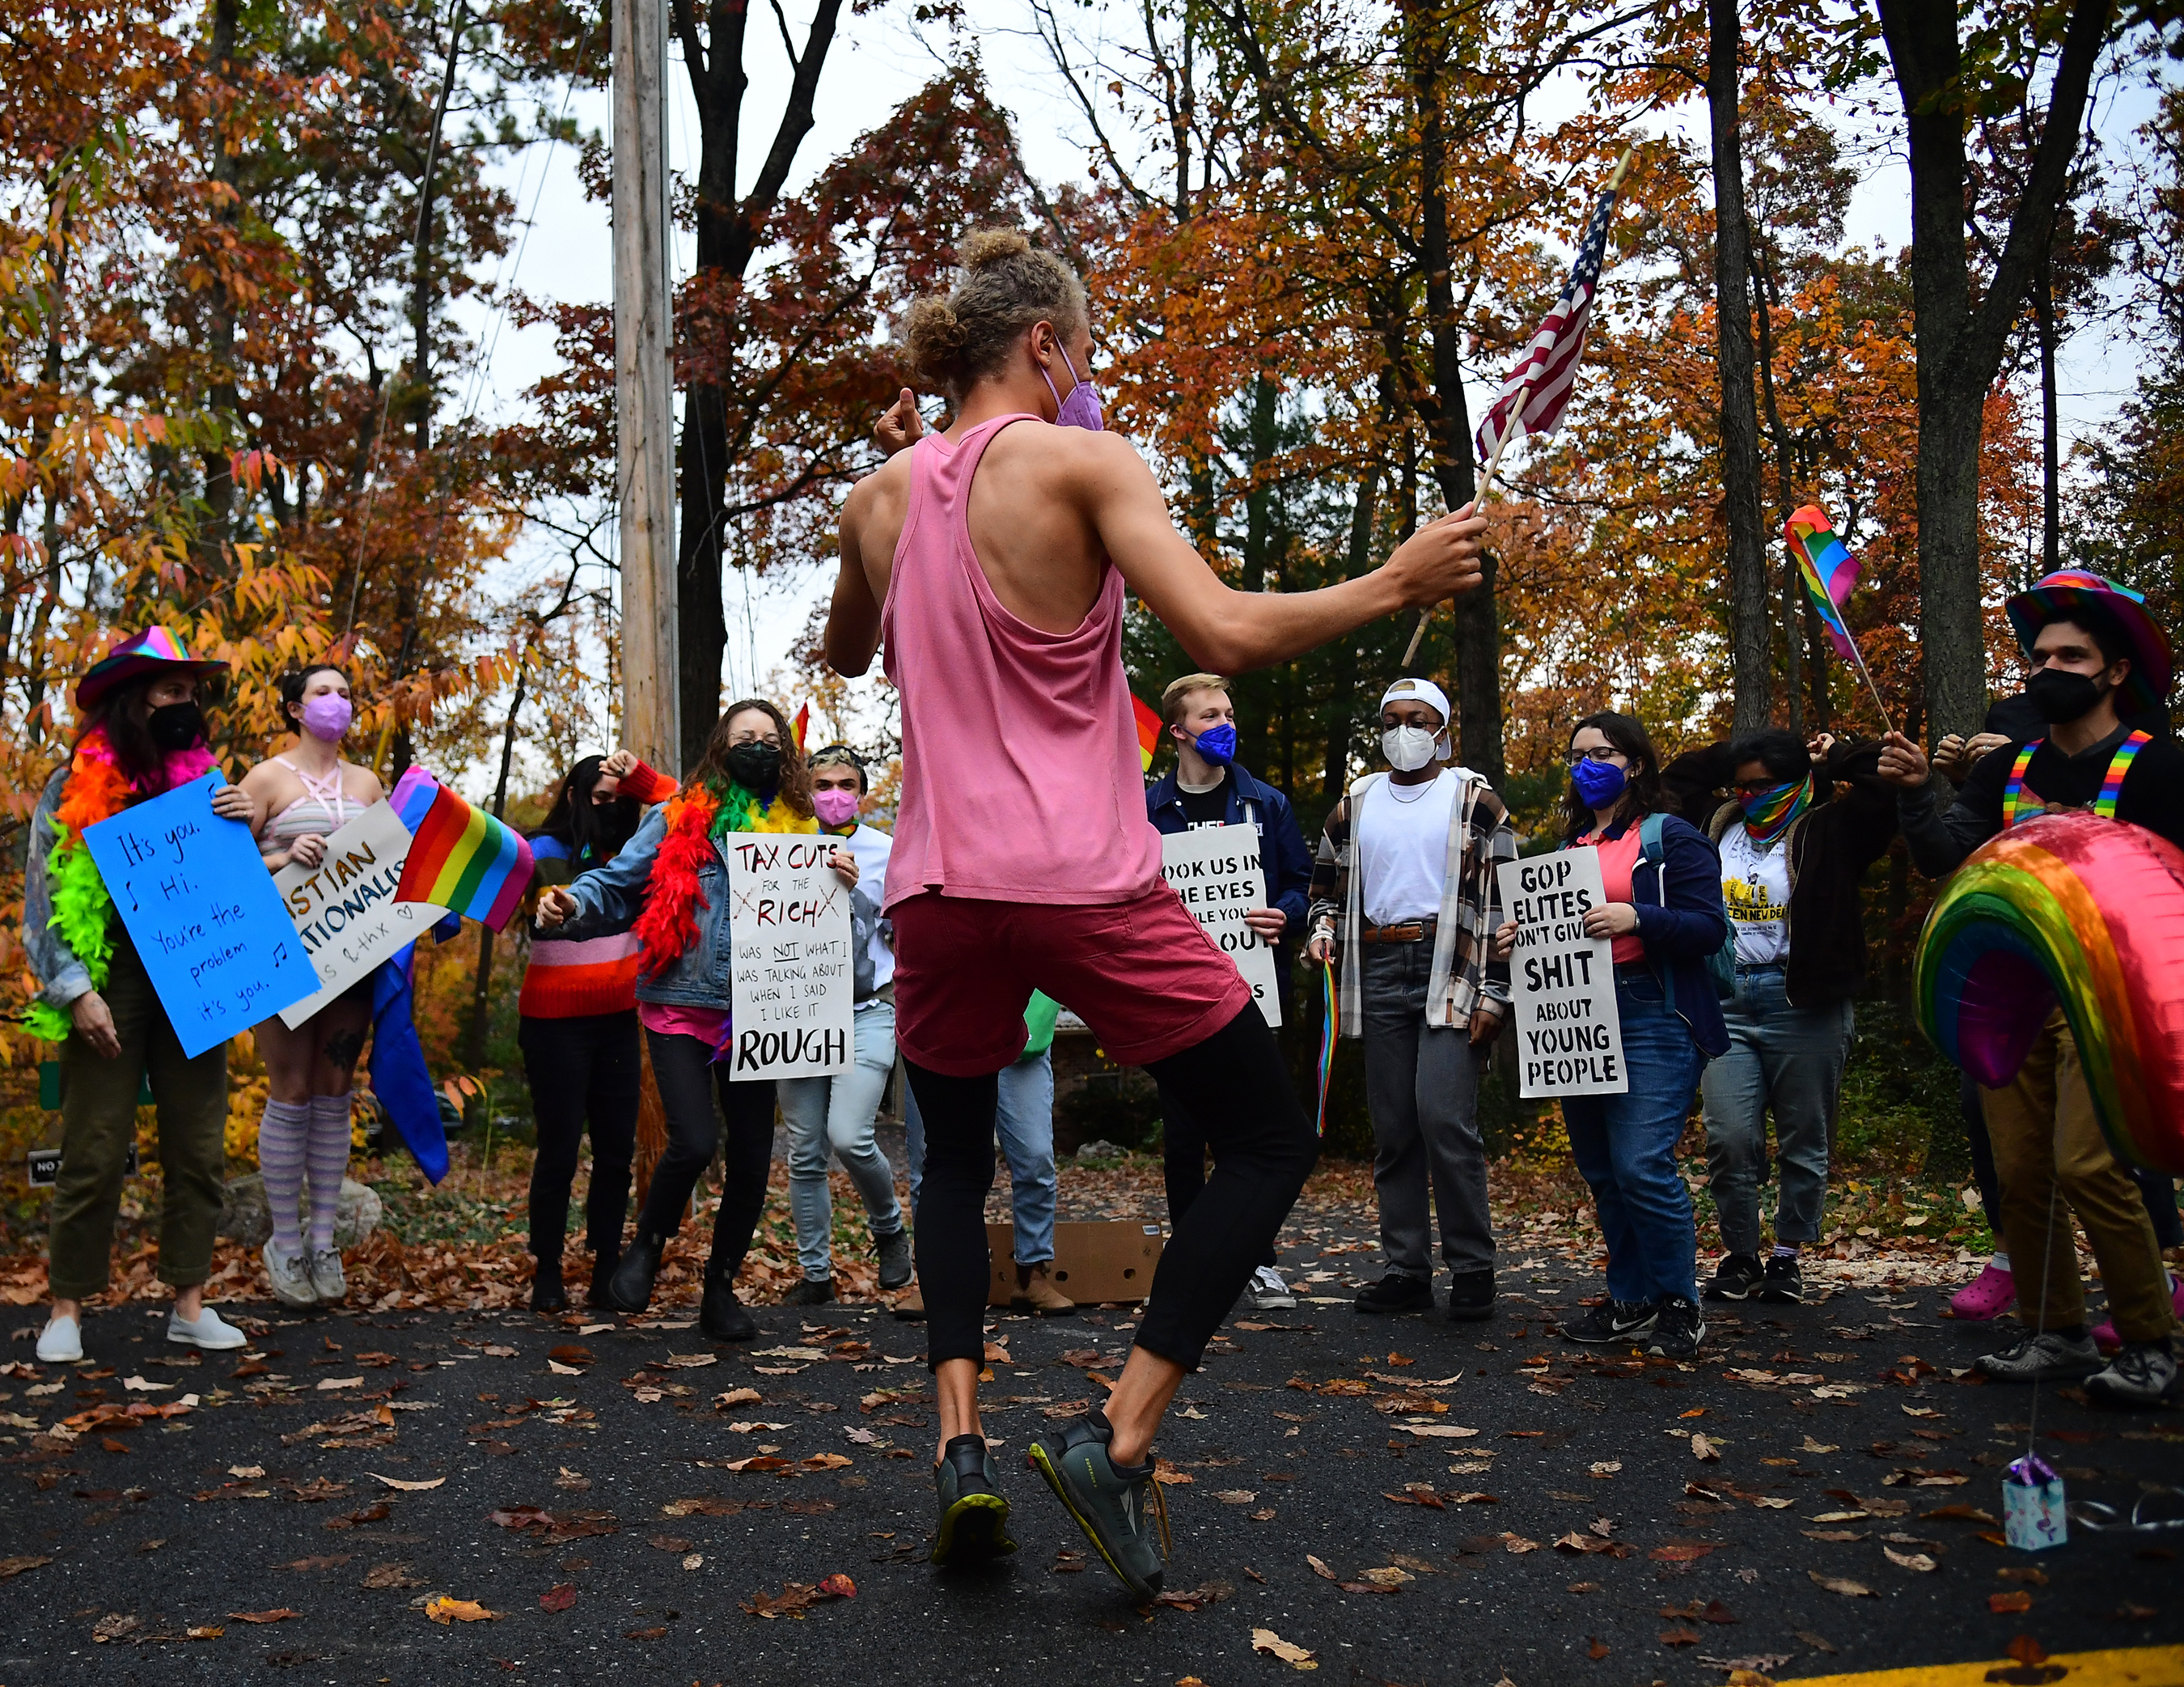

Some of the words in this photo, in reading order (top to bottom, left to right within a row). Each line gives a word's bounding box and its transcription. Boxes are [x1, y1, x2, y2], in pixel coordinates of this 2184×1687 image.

[117, 833, 154, 867] It's
[164, 821, 201, 863] you.
[734, 843, 781, 873] TAX
[788, 843, 838, 869] CUTS
[1210, 857, 1238, 875] US
[1521, 860, 1572, 892] GOP
[160, 873, 198, 901] Hi.
[761, 880, 780, 893] FOR
[793, 877, 810, 890] THE
[1205, 880, 1255, 902] EYES
[757, 899, 818, 928] RICH
[1513, 888, 1593, 925] ELITES
[1750, 909, 1768, 921] NEW
[151, 925, 206, 954] You're
[211, 902, 245, 928] the
[739, 946, 762, 960] WAS
[773, 942, 799, 959] NOT
[806, 940, 839, 957] WHAT
[843, 941, 847, 957] I
[189, 943, 248, 987] problem
[737, 969, 759, 983] WAS
[764, 965, 806, 982] TALKING
[812, 963, 845, 977] ABOUT
[1524, 950, 1594, 992] SHIT
[197, 1000, 226, 1021] it's
[235, 981, 270, 1012] you.
[750, 987, 781, 1003] WHEN
[790, 985, 796, 999] I
[804, 983, 827, 998] SAID
[760, 1008, 768, 1021] I
[774, 1006, 800, 1020] LIKE
[808, 1002, 819, 1016] IT
[1536, 998, 1592, 1023] ABOUT
[737, 1028, 845, 1071] ROUGH
[1526, 1024, 1610, 1055] YOUNG
[1527, 1054, 1618, 1087] PEOPLE
[36, 1161, 55, 1172] NO
